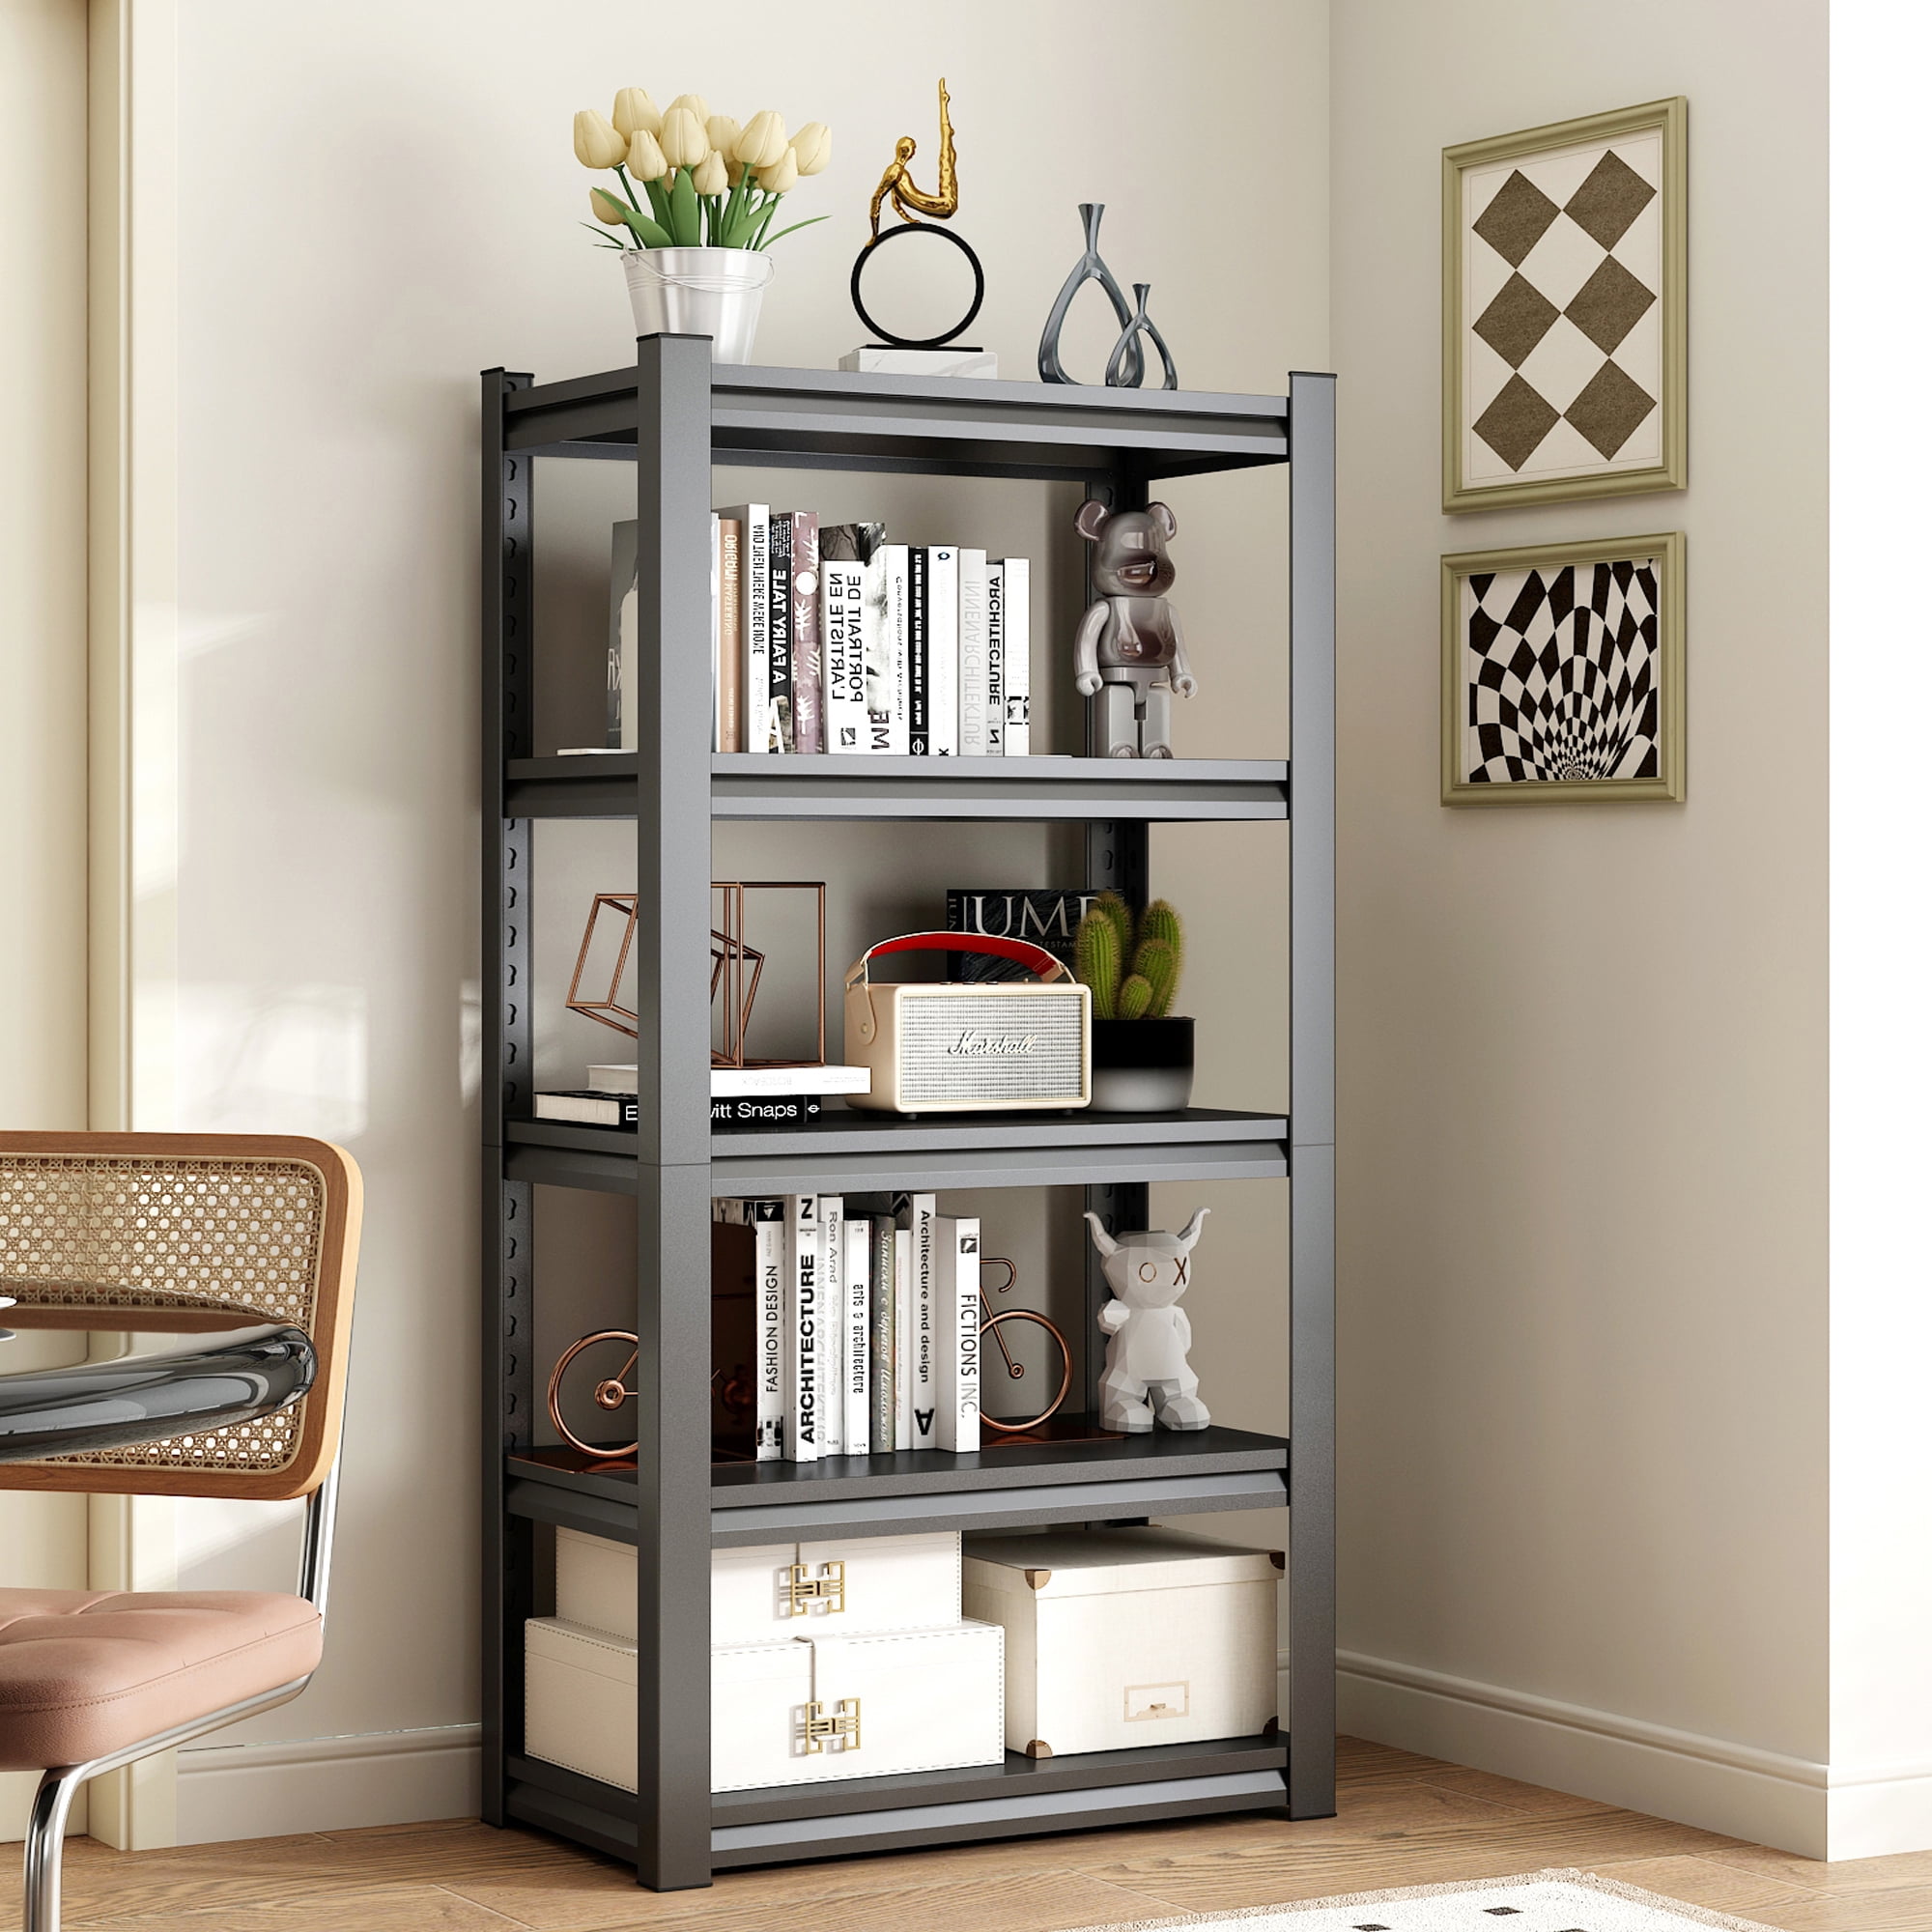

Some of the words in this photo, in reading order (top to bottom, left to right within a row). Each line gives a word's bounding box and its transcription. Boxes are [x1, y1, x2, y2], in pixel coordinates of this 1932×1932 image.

[948, 1029, 1037, 1055] Marshall
[737, 1102, 798, 1120] Snaps
[829, 1211, 838, 1242] Ron
[829, 1247, 838, 1284] Arad
[921, 1209, 930, 1300] Architecture
[765, 1265, 778, 1321] DESIGN
[853, 1284, 865, 1306] arts
[921, 1303, 930, 1330] and
[960, 1293, 978, 1377] FICTIONS
[766, 1326, 779, 1392] FASHION
[800, 1254, 815, 1444] ARCHITECTURE
[853, 1325, 867, 1394] architecture
[919, 1335, 930, 1383] design
[960, 1382, 979, 1419] INC.
